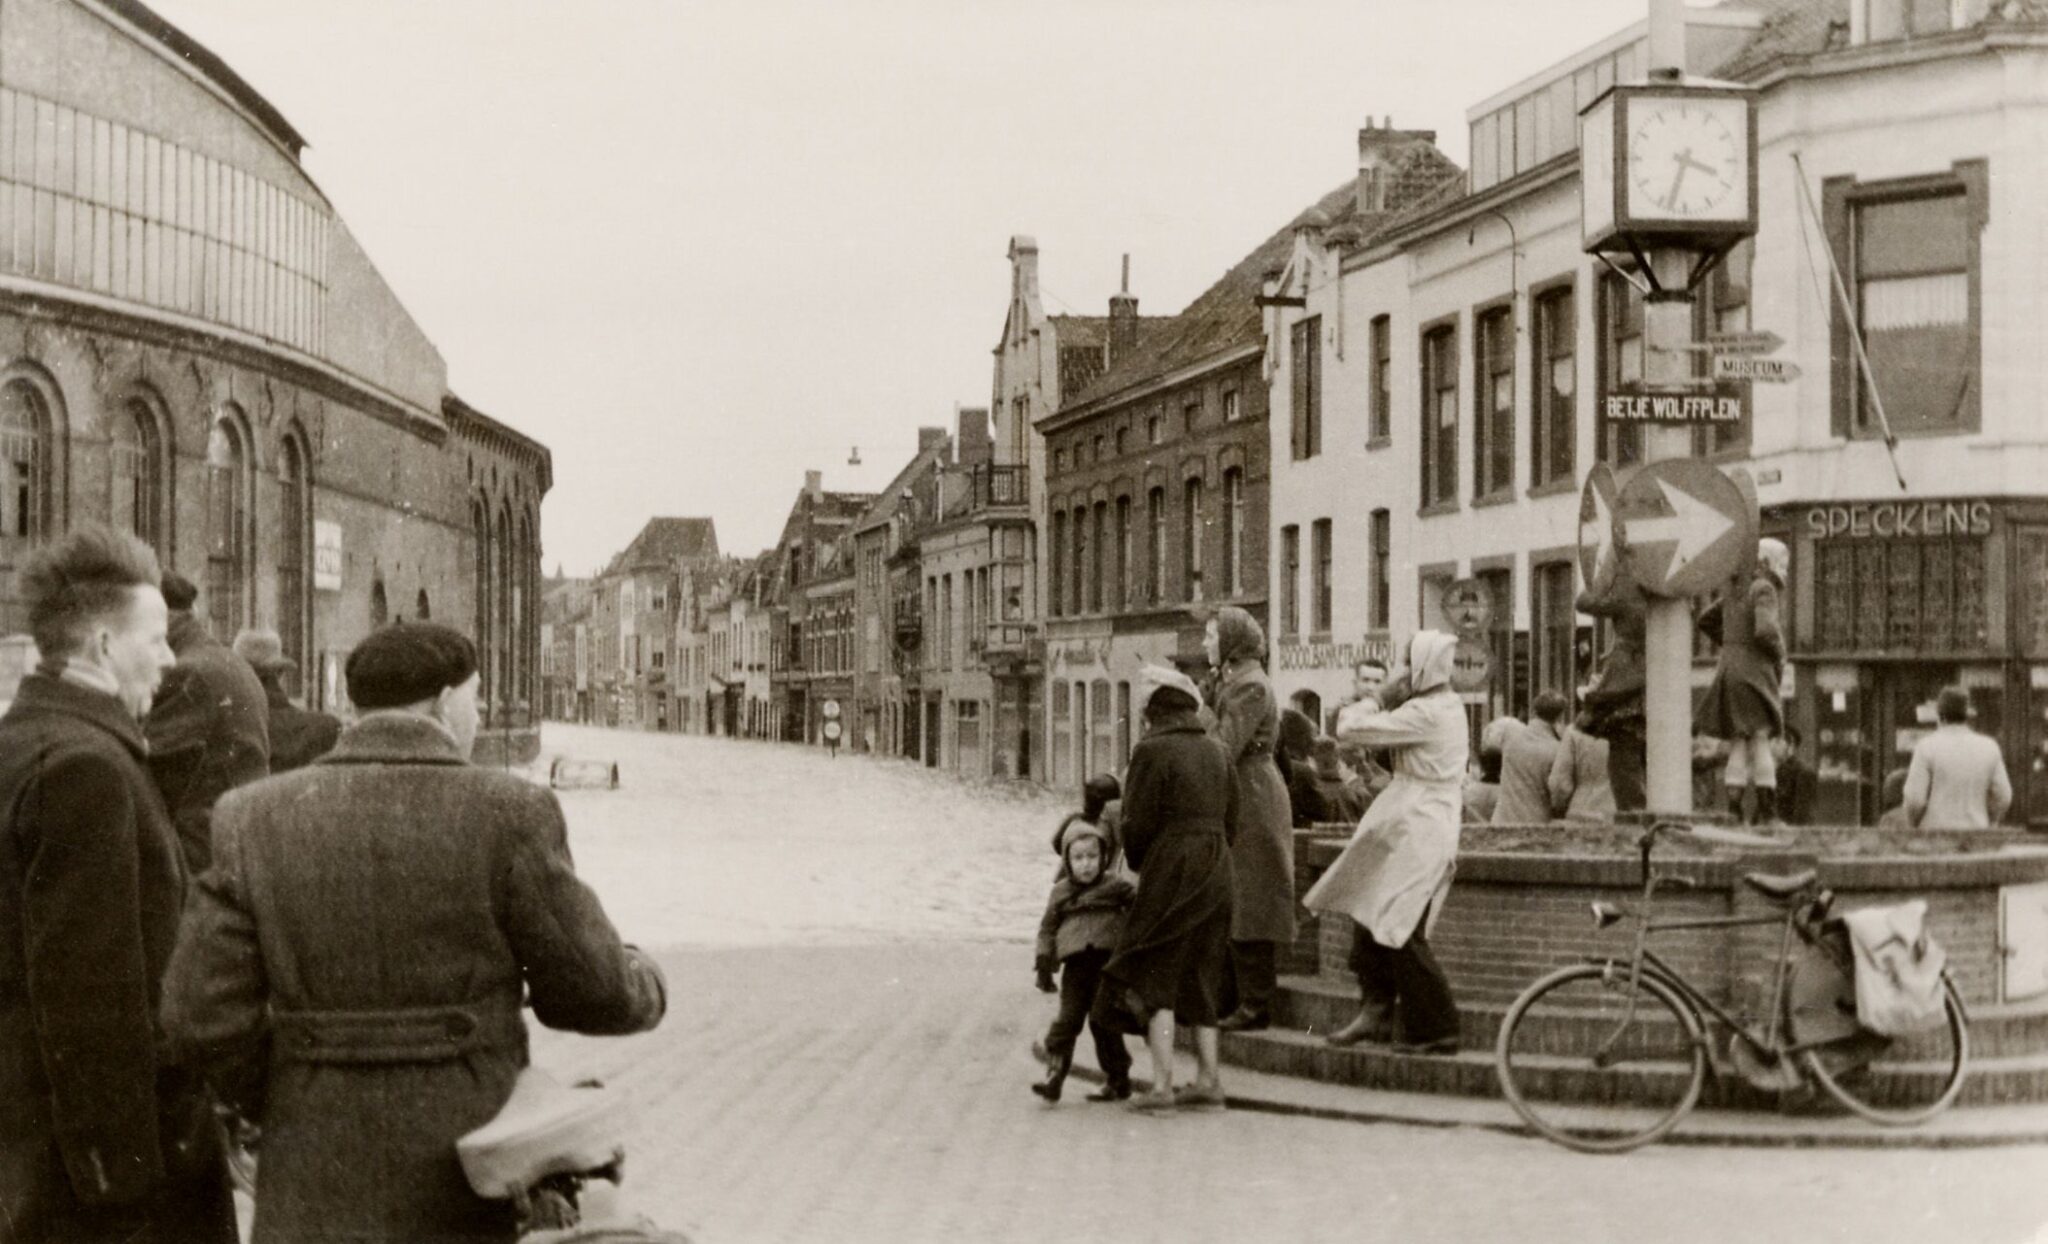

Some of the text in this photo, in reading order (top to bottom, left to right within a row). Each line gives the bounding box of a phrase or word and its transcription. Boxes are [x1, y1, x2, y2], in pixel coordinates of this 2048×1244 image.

[1722, 360, 1783, 374] MUSEUM
[1607, 396, 1741, 420] BETJE WOLFFPLEIN
[1807, 502, 1992, 539] SPECKENS
